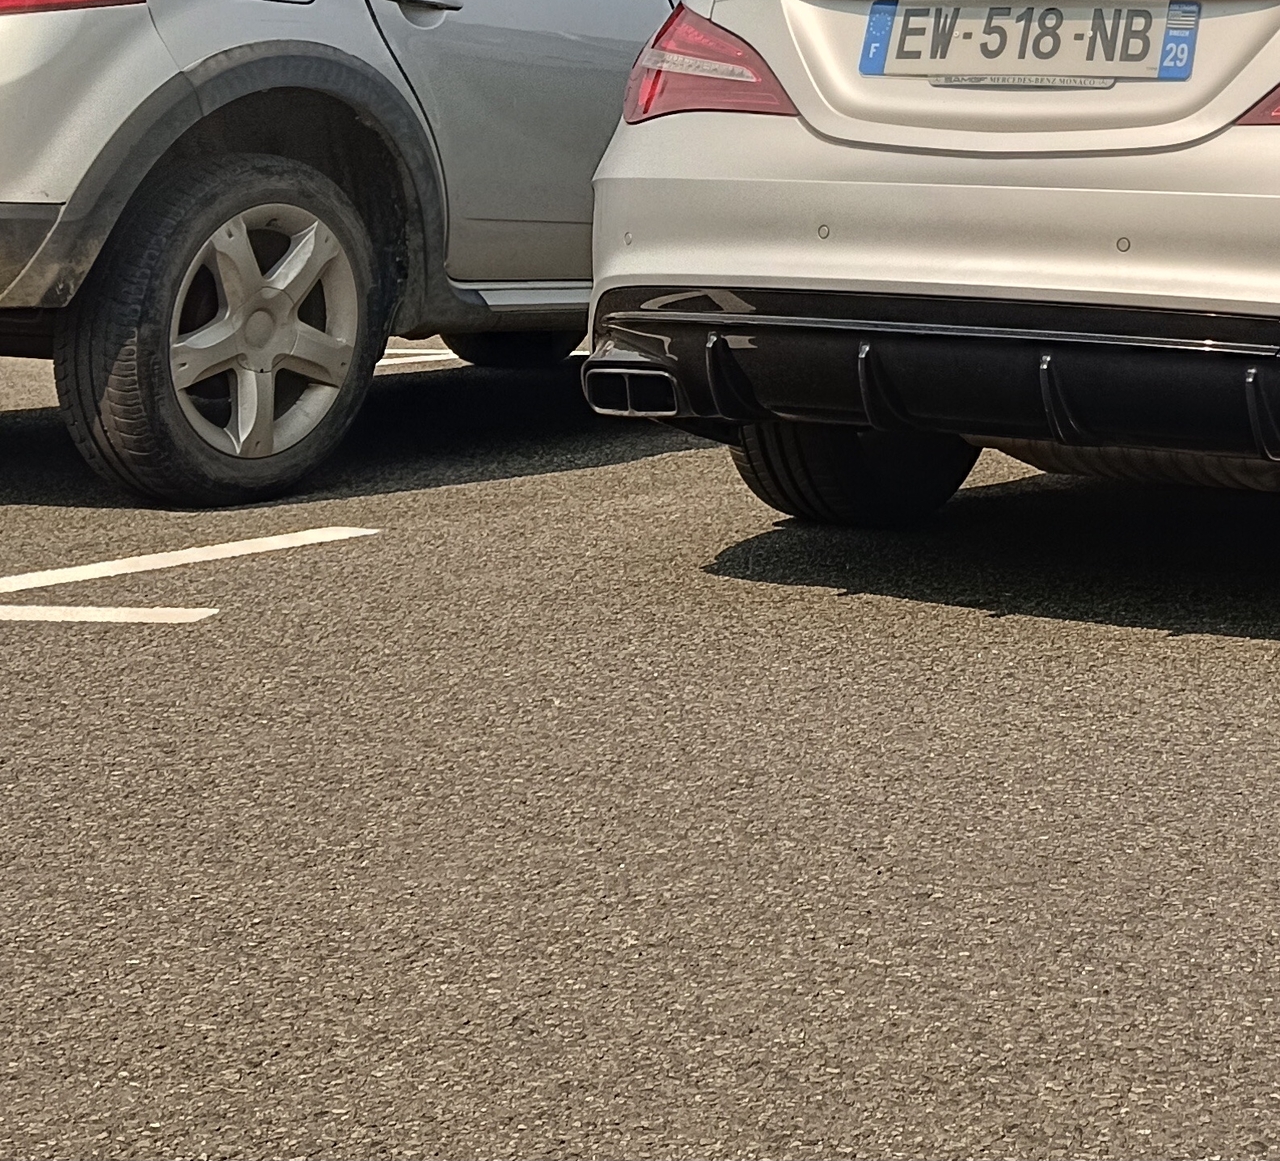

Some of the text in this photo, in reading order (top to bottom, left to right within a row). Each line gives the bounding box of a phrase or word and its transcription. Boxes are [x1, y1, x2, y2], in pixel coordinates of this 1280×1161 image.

[895, 6, 1153, 62] EW-518-NB
[868, 43, 880, 58] F
[1162, 42, 1188, 67] 29
[989, 76, 1096, 86] MERCEDES-BENZ MONACO
